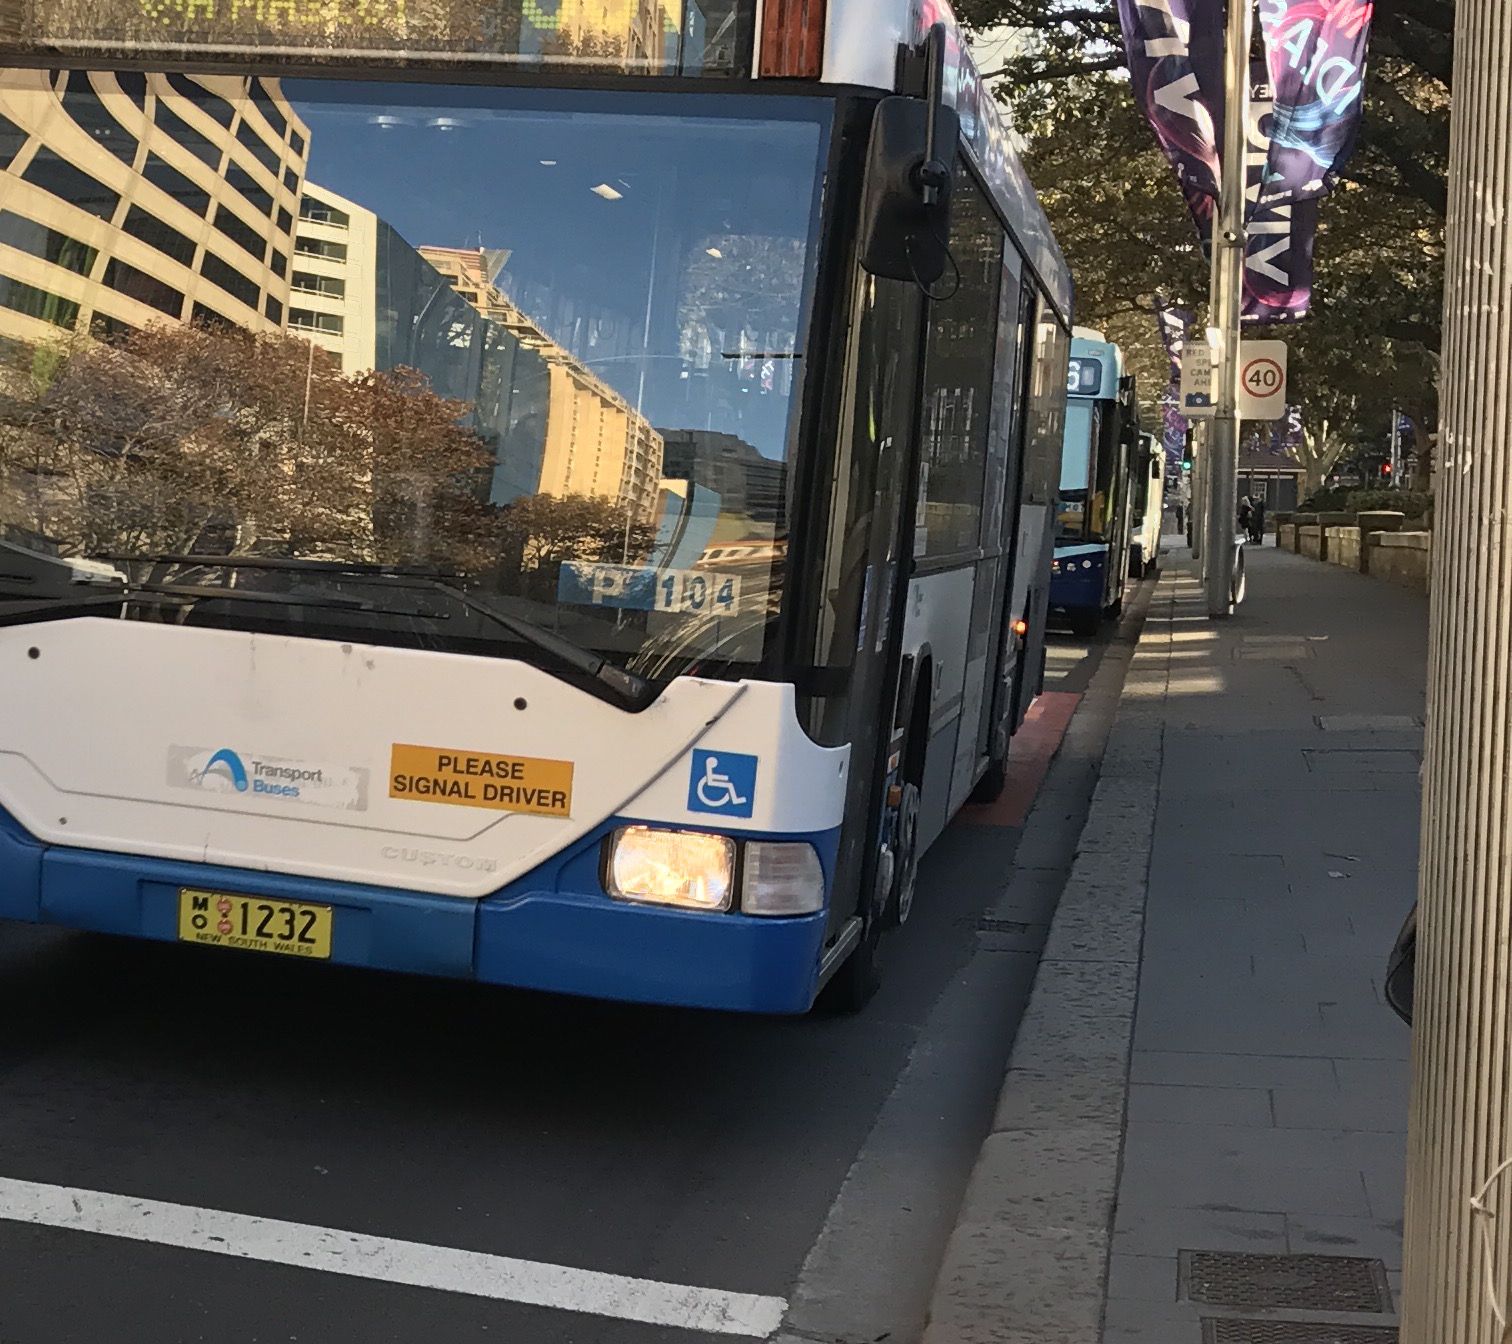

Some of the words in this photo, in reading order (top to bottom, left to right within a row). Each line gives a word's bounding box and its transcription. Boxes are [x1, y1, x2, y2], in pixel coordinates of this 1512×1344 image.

[1248, 369, 1277, 387] 40
[661, 574, 735, 612] 104
[252, 760, 323, 783] Transport
[437, 755, 525, 780] PLEASE
[253, 779, 300, 798] Buses
[392, 774, 476, 799] SIGNAL
[483, 783, 567, 809] DRIVER
[380, 845, 498, 873] CUSTOM
[240, 901, 317, 945] 1232
[196, 931, 222, 944] NEW
[228, 936, 268, 951] SOUTH
[273, 942, 314, 956] WALES
